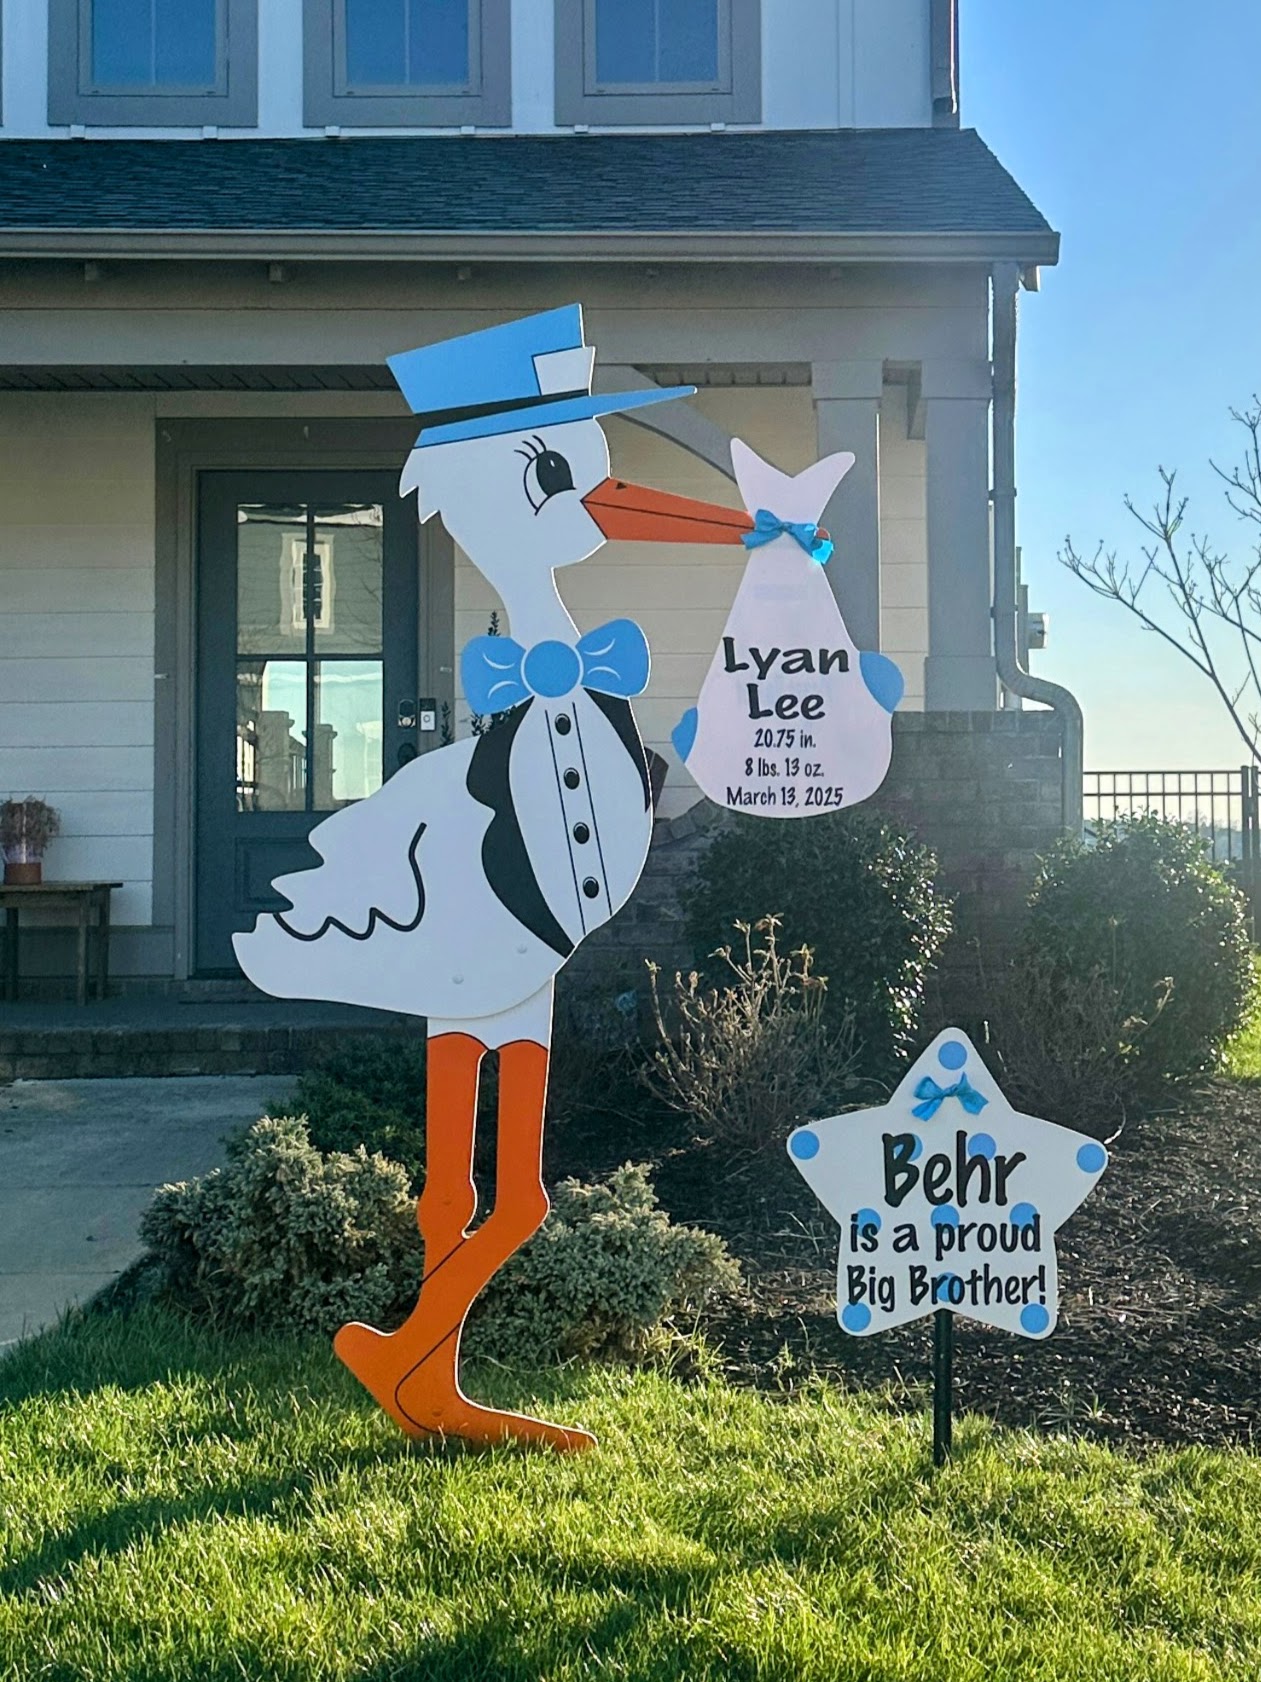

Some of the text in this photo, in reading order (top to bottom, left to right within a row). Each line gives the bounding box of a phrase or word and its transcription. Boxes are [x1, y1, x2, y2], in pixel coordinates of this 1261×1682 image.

[722, 636, 849, 680] Lyan
[747, 683, 825, 720] Lee
[754, 728, 816, 748] 20.75 in.
[745, 757, 824, 777] 8 lbs. 13 oz.
[727, 786, 843, 808] March 13, 2025
[882, 1130, 1026, 1208] Behr
[850, 1213, 1041, 1261] is a proud
[847, 1263, 1046, 1313] Big Brother!
